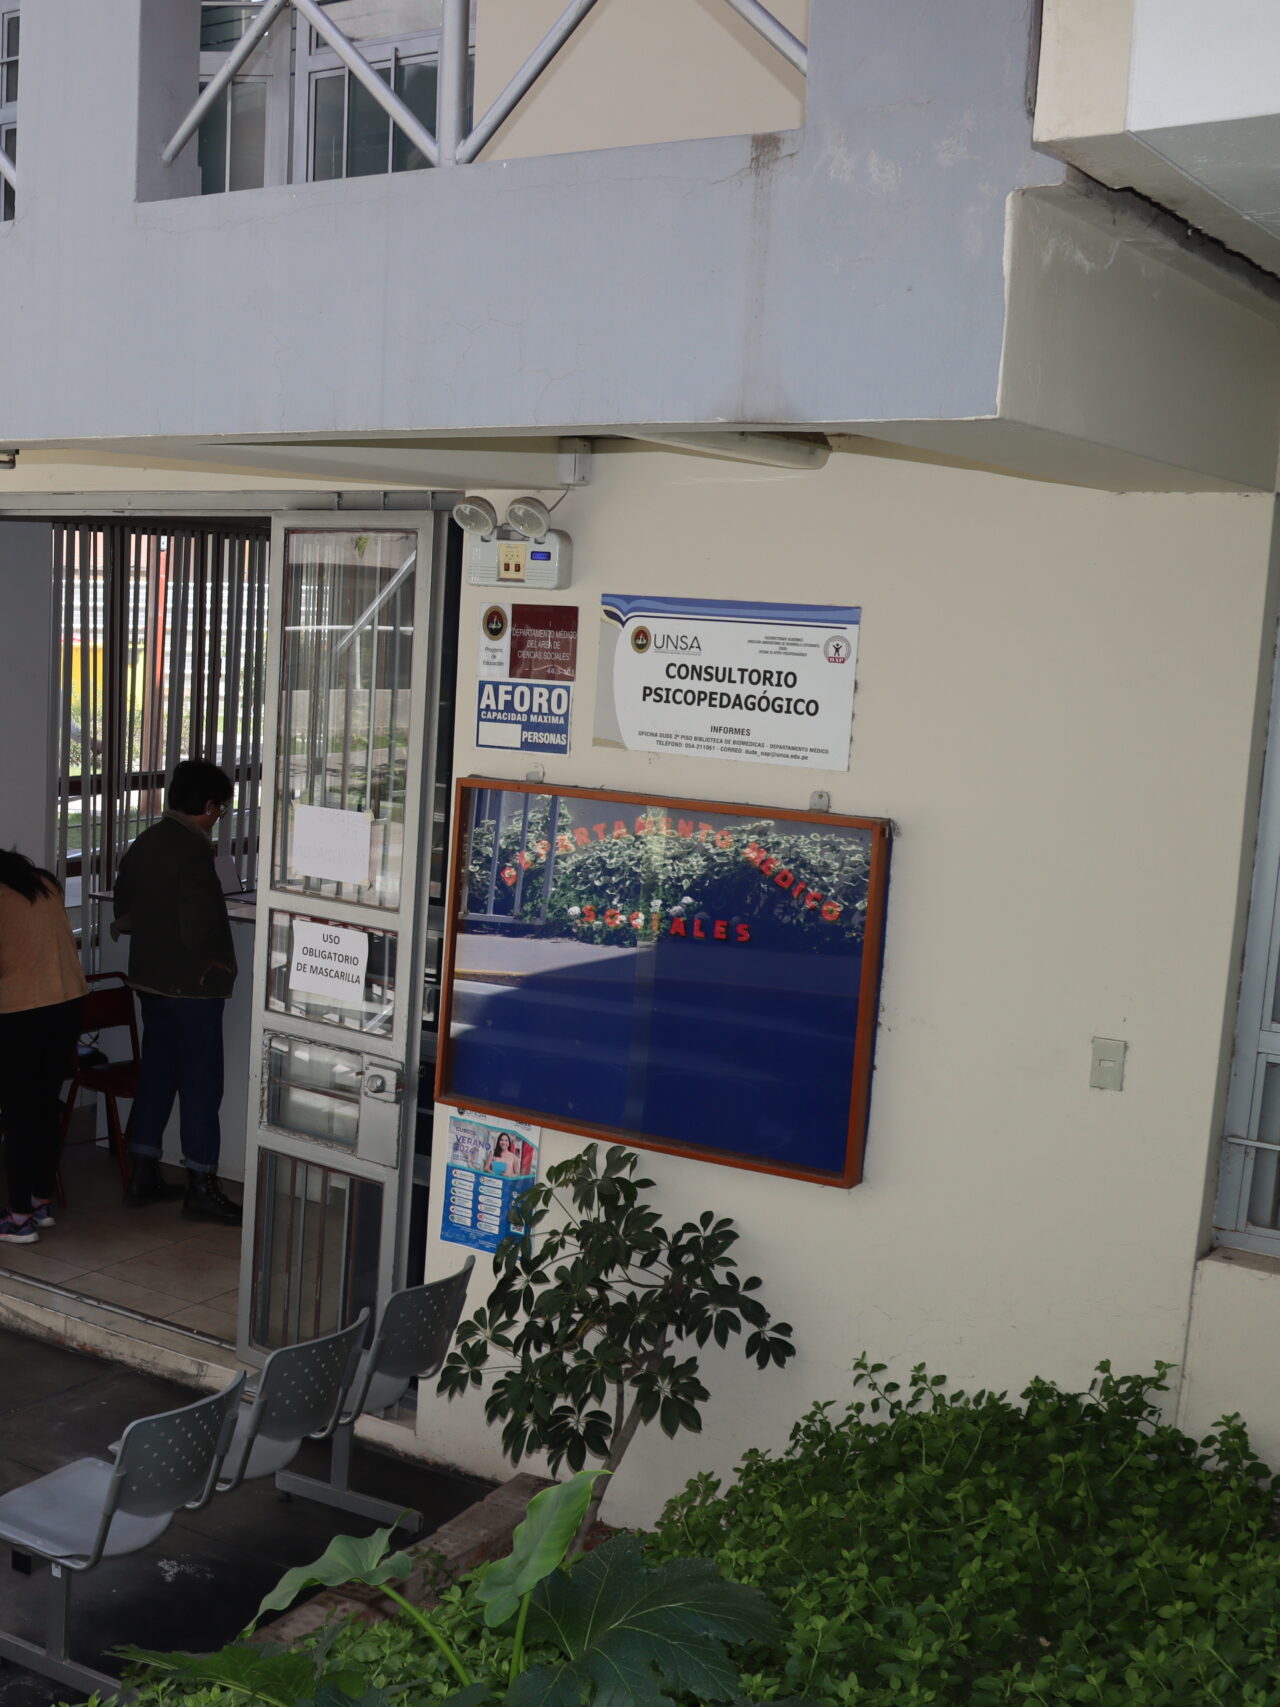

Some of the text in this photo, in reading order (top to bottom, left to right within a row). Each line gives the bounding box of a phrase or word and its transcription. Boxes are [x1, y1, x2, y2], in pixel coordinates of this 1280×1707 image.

[653, 633, 702, 652] UNSA
[517, 650, 570, 661] CIENCIAS SOCIALES
[665, 662, 798, 689] CONSULTORIO
[479, 683, 569, 716] AFORO
[642, 685, 820, 717] PSICOPEDAGÓGICO
[481, 710, 565, 725] CAPACIDAD MAXIMA
[521, 730, 567, 745] PERSONAS
[709, 725, 751, 737] INFORMES
[693, 735, 723, 744] BIBLIOTECA
[769, 743, 808, 753] DEPARTAMENTO
[742, 841, 842, 922] MEDICO
[581, 904, 751, 943] SOCIALES
[322, 933, 341, 945] USO
[301, 946, 360, 967] OBLIGATORIO
[296, 962, 362, 985] DE MASCARILLA
[455, 1134, 492, 1151] VERANO
